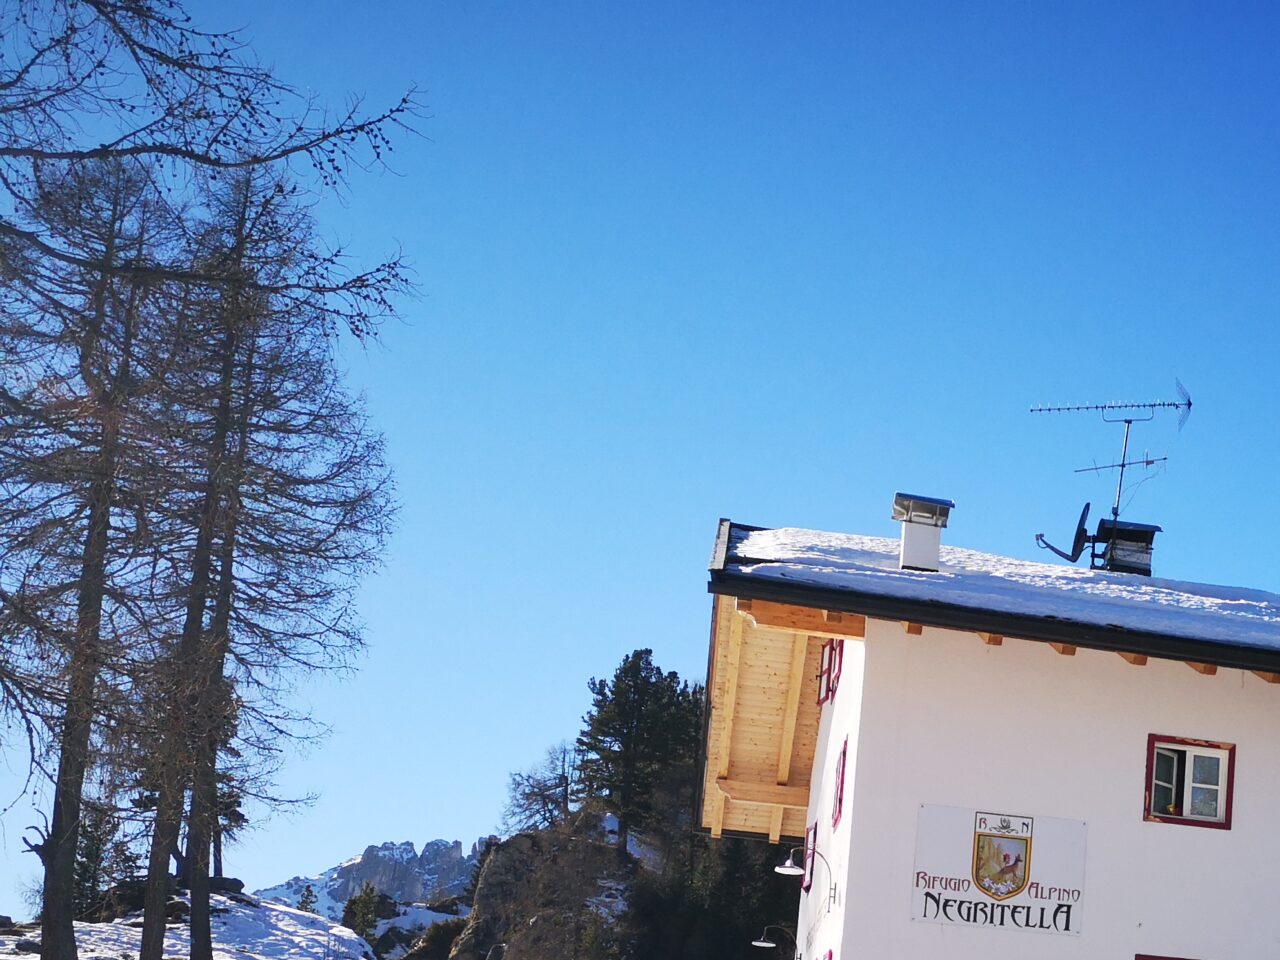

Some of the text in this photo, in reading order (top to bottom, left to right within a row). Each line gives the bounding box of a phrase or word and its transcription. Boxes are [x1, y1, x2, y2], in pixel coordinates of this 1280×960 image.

[1022, 821, 1030, 833] N
[915, 871, 1081, 903] RIFUGIO ALPINO
[922, 891, 1073, 932] NEGRITELLA
